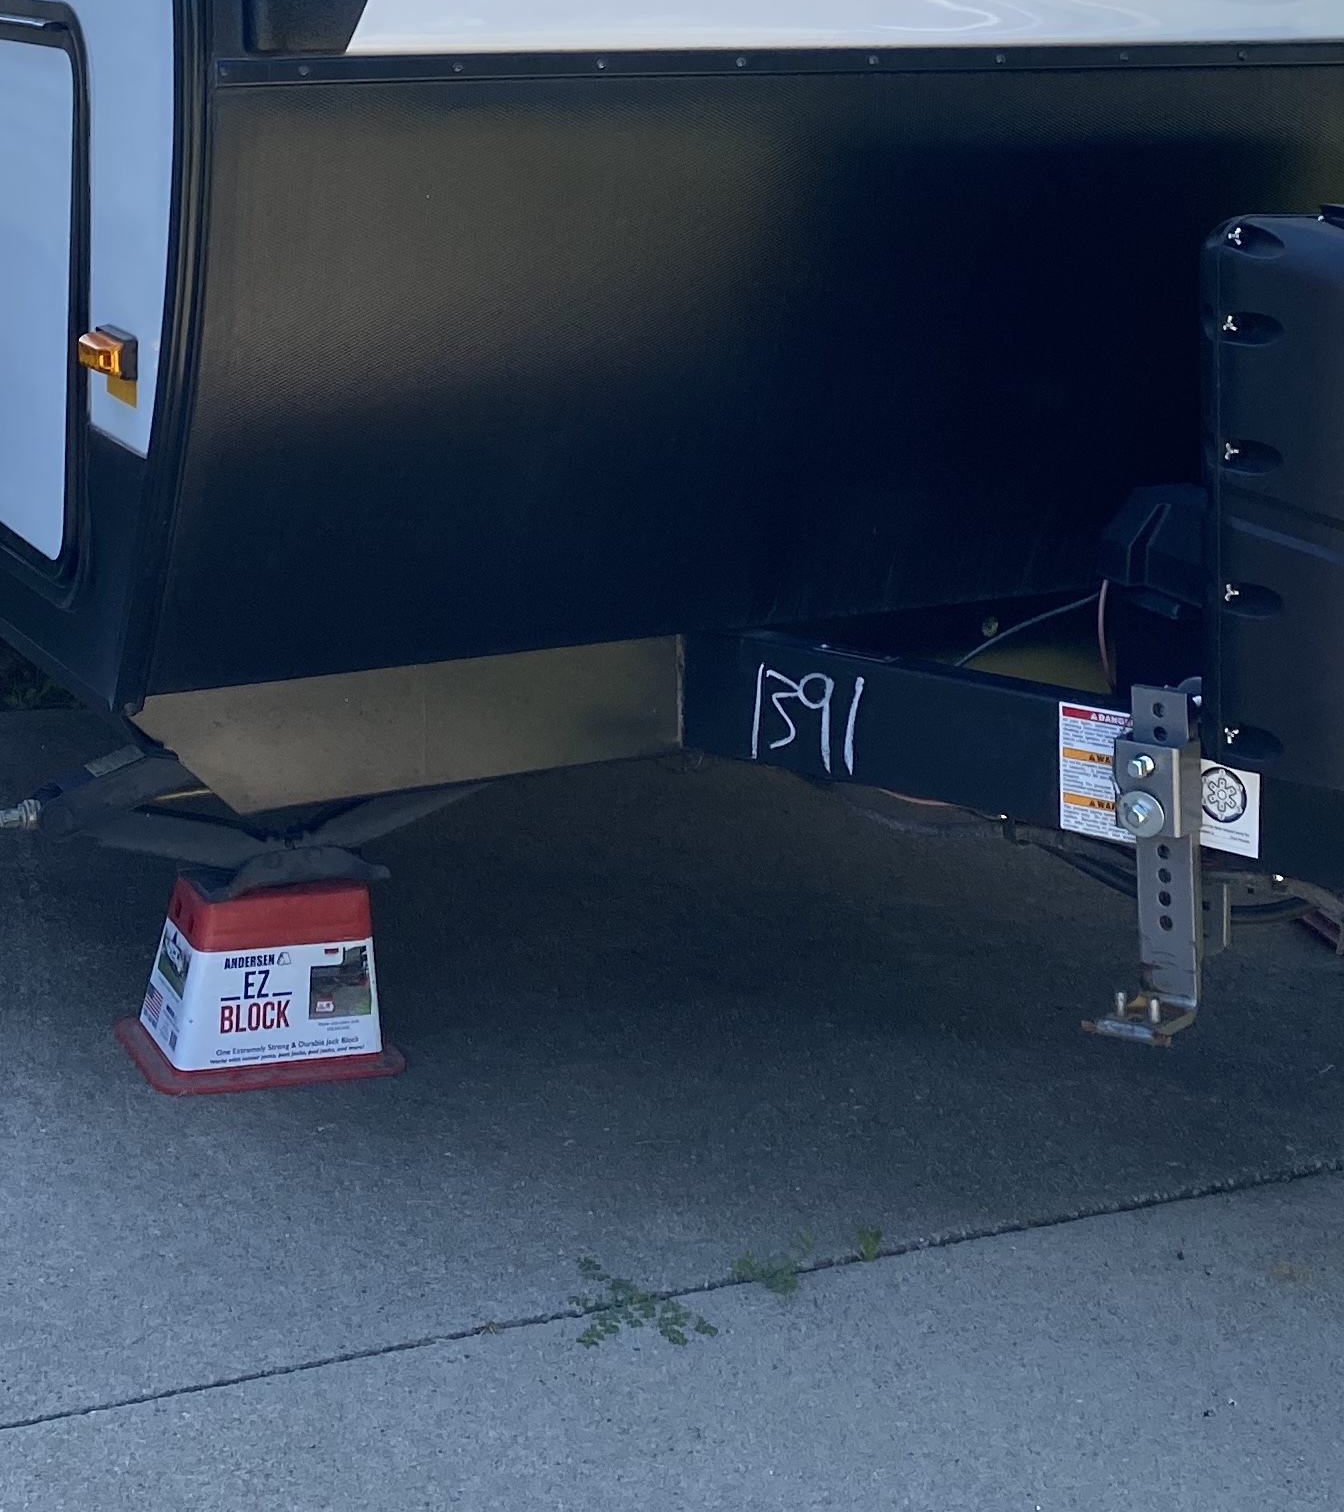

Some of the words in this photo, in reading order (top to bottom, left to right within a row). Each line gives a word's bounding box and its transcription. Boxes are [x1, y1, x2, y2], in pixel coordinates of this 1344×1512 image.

[224, 953, 275, 970] ANDERSEN
[243, 969, 270, 1000] EZ
[220, 999, 291, 1034] BLOCK
